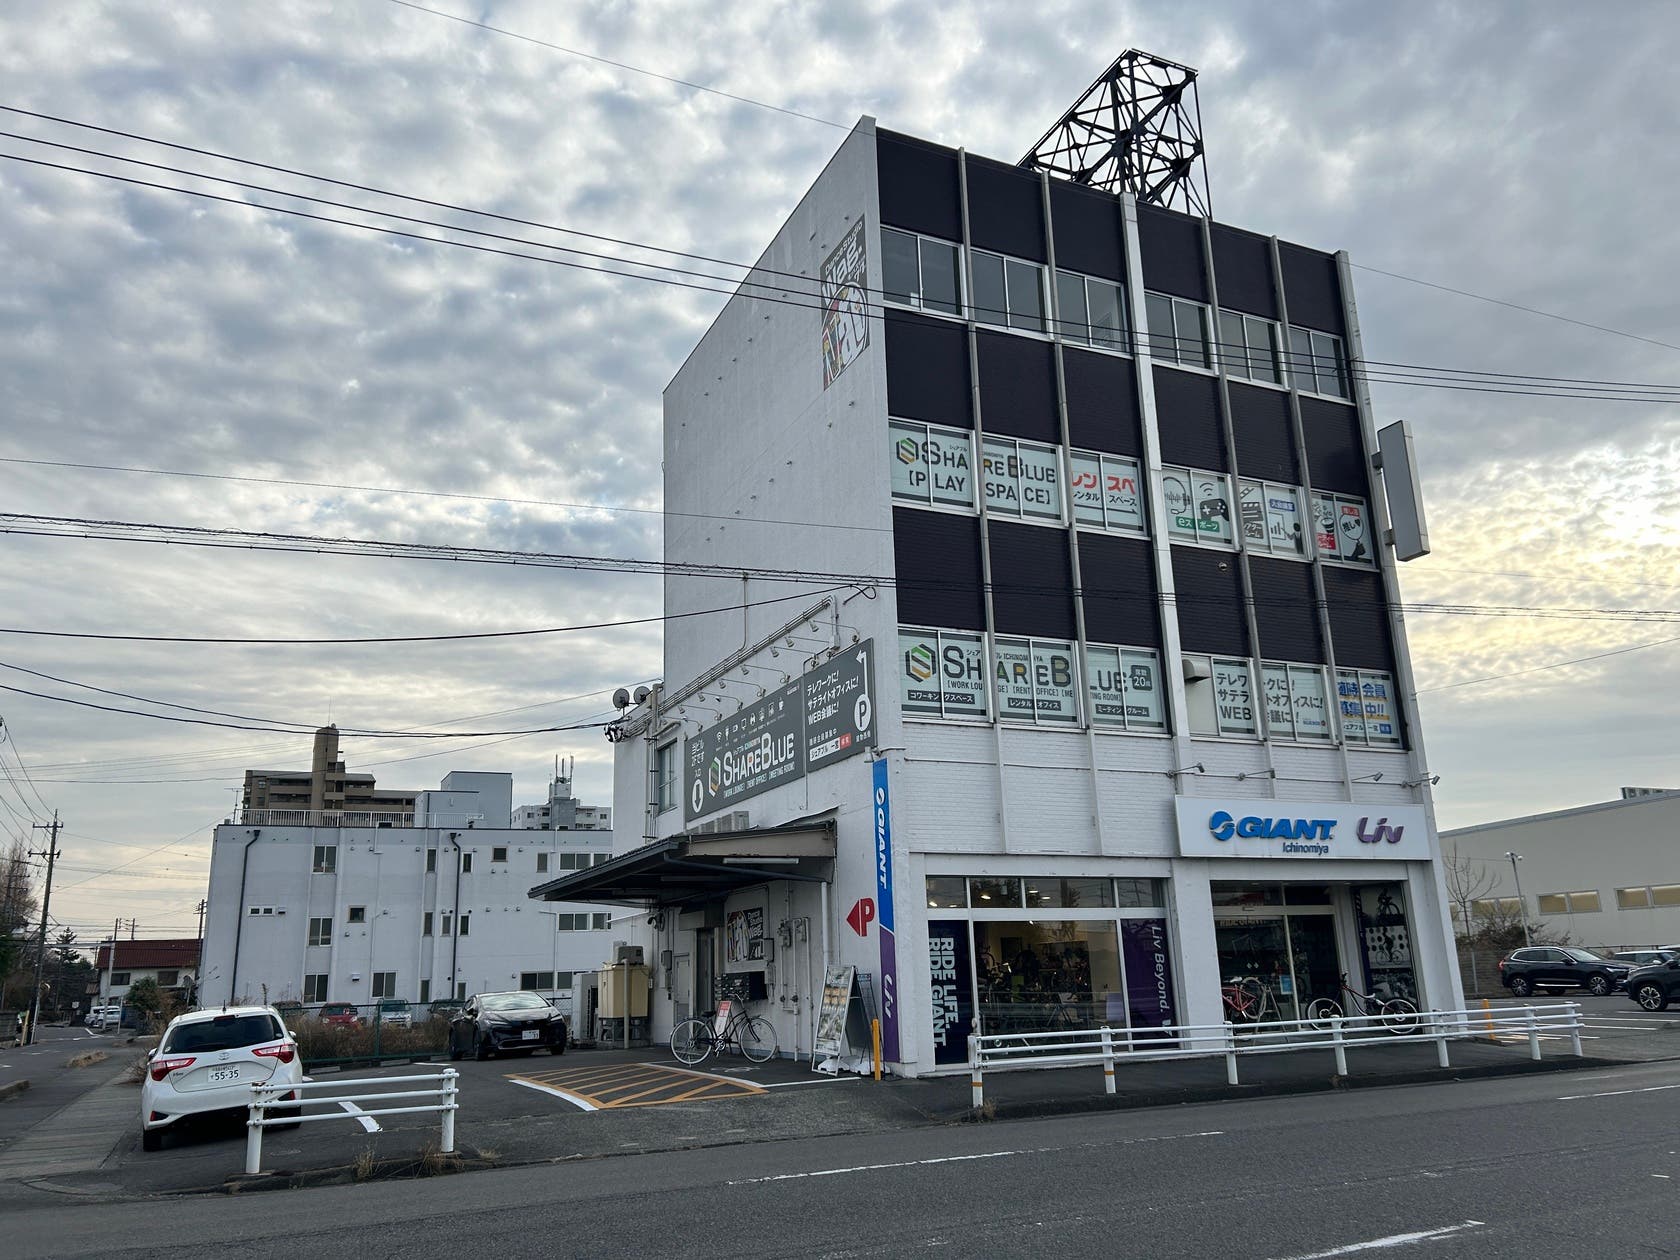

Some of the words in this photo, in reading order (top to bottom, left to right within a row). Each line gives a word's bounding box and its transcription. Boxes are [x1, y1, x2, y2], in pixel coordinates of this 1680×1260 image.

[858, 700, 867, 728] P
[909, 691, 974, 703] コワーキングスペース
[1010, 700, 1060, 709] レンタルオフィス
[877, 807, 887, 890] GIANT
[1236, 816, 1338, 840] GIANT
[1356, 816, 1405, 844] Liv
[1283, 842, 1329, 856] Ichinomiya
[861, 897, 875, 937] P
[1151, 926, 1162, 949] Liv
[928, 937, 942, 981] RIDE
[941, 937, 957, 981] RIDE
[1154, 953, 1170, 1013] Beyond.
[931, 985, 947, 1049] GIANT.
[943, 984, 959, 1029] LIFE.
